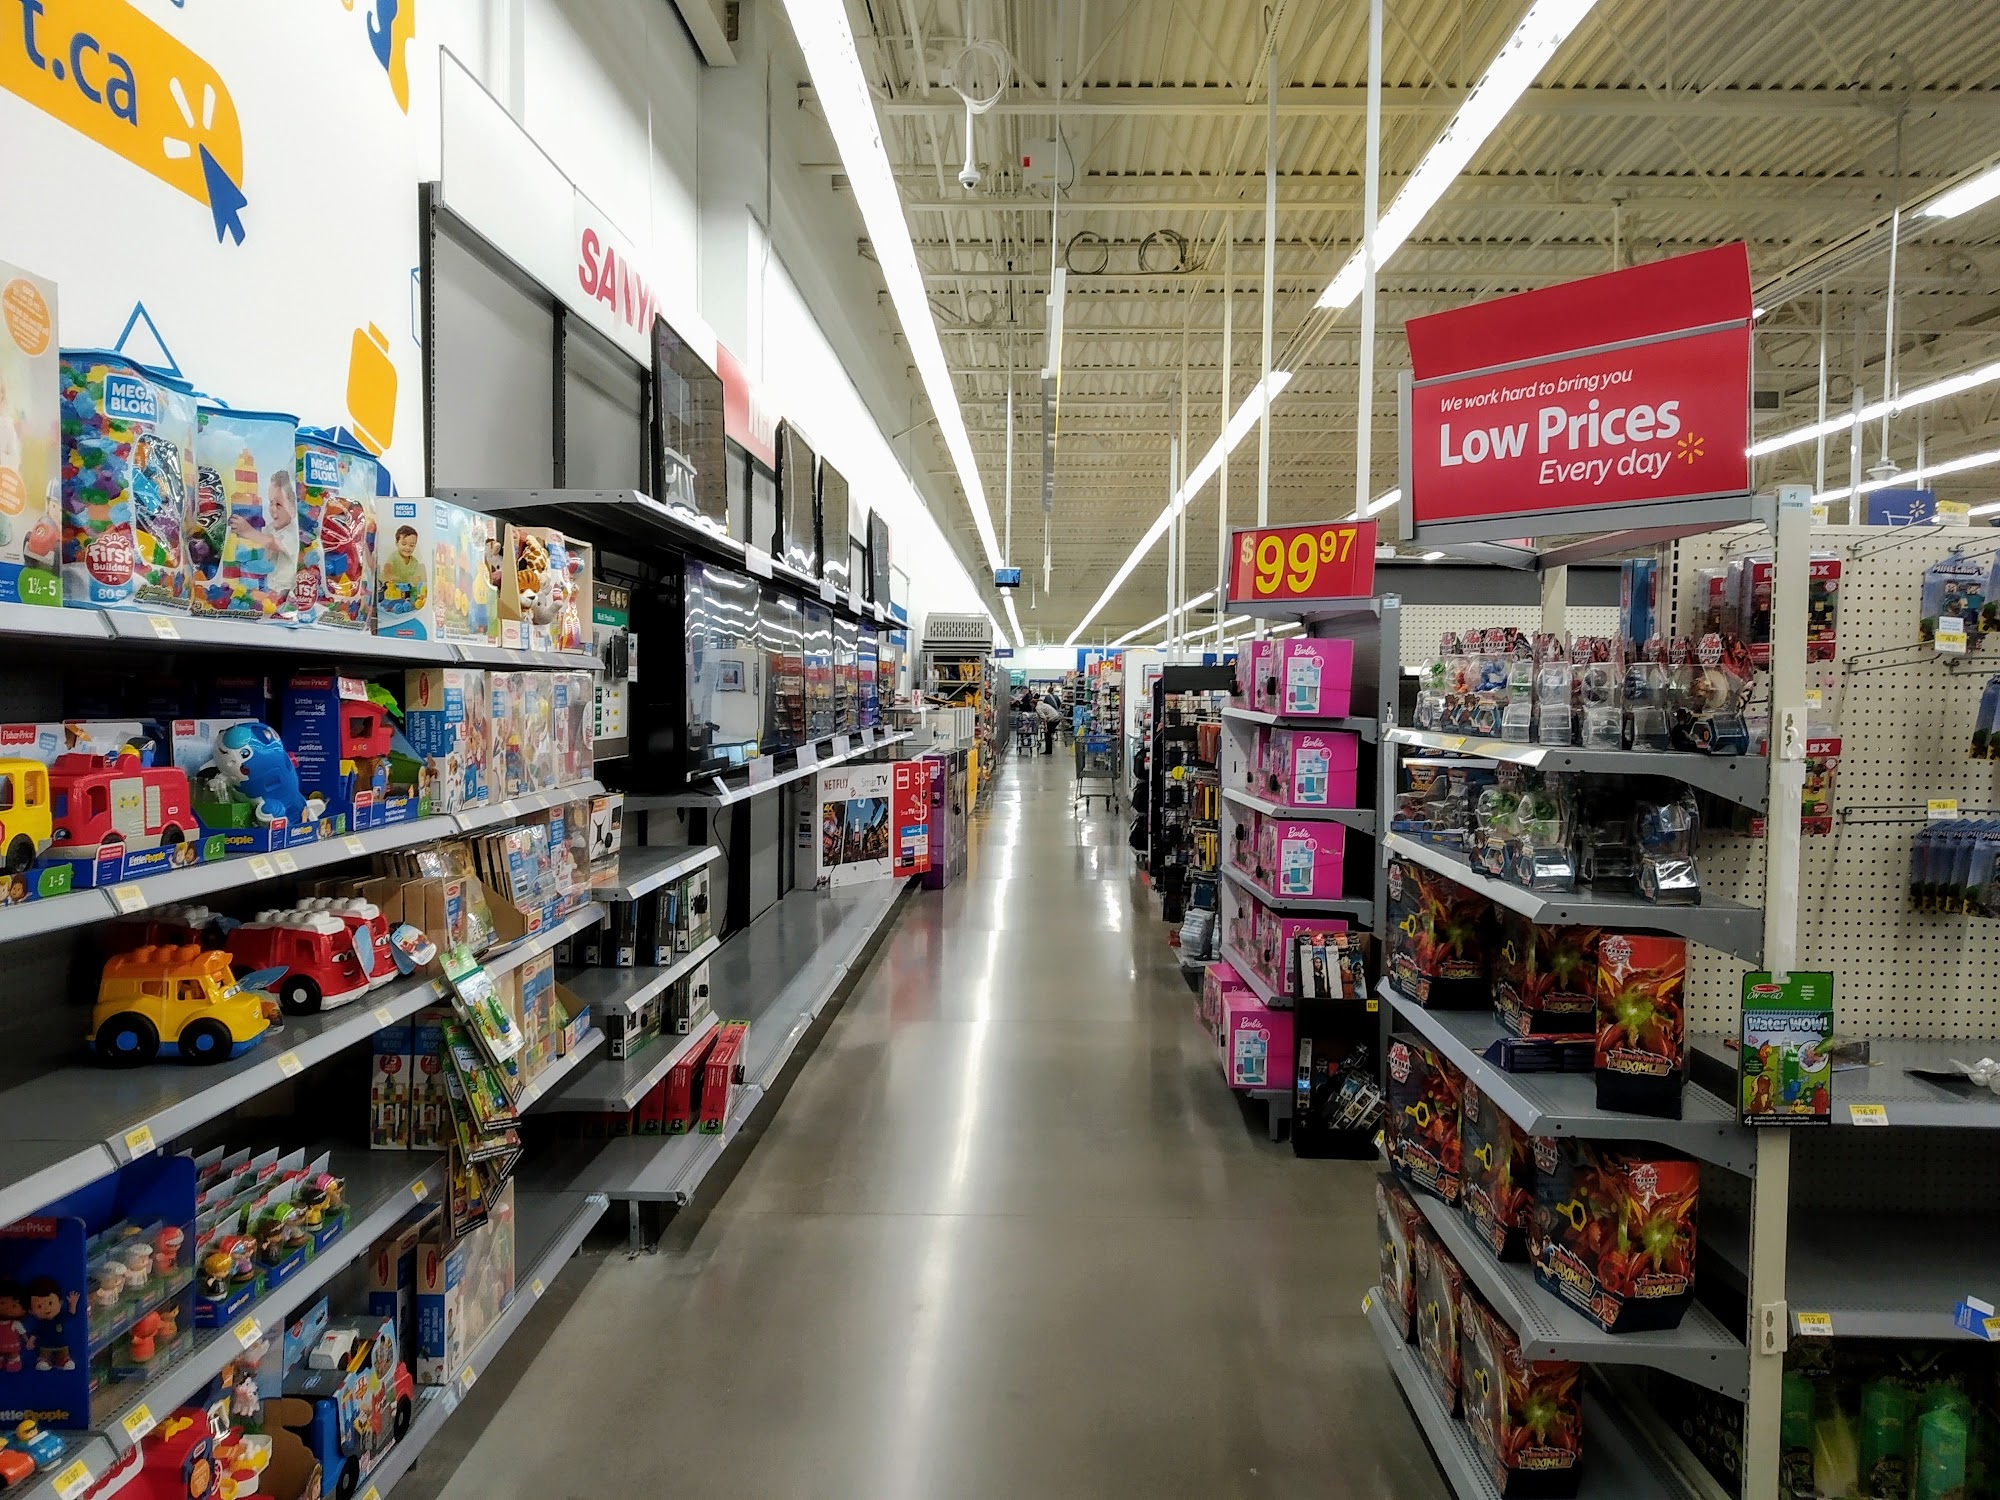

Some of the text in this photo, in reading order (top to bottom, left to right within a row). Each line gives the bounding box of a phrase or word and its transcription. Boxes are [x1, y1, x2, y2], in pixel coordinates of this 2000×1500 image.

[111, 382, 154, 402] MEGA
[1440, 369, 1633, 413] We work hard to bring you
[110, 397, 155, 416] BLOKS
[1440, 398, 1681, 467] Low Prices
[311, 458, 336, 471] MEGA
[1538, 448, 1673, 486] Every day
[310, 470, 338, 482] BLOKS
[90, 545, 132, 564] First
[93, 562, 130, 573] Builders
[1932, 563, 1984, 576] MINECRAFT
[107, 574, 118, 582] 1+
[1293, 643, 1318, 656] Barbie
[1302, 735, 1325, 748] Barbie
[1287, 826, 1310, 838] Barbie
[224, 835, 254, 846] eople
[48, 873, 65, 888] 1-5
[1240, 1016, 1263, 1029] Barbie
[1747, 1016, 1829, 1032] Water WOW!
[1744, 1115, 1753, 1126] 4
